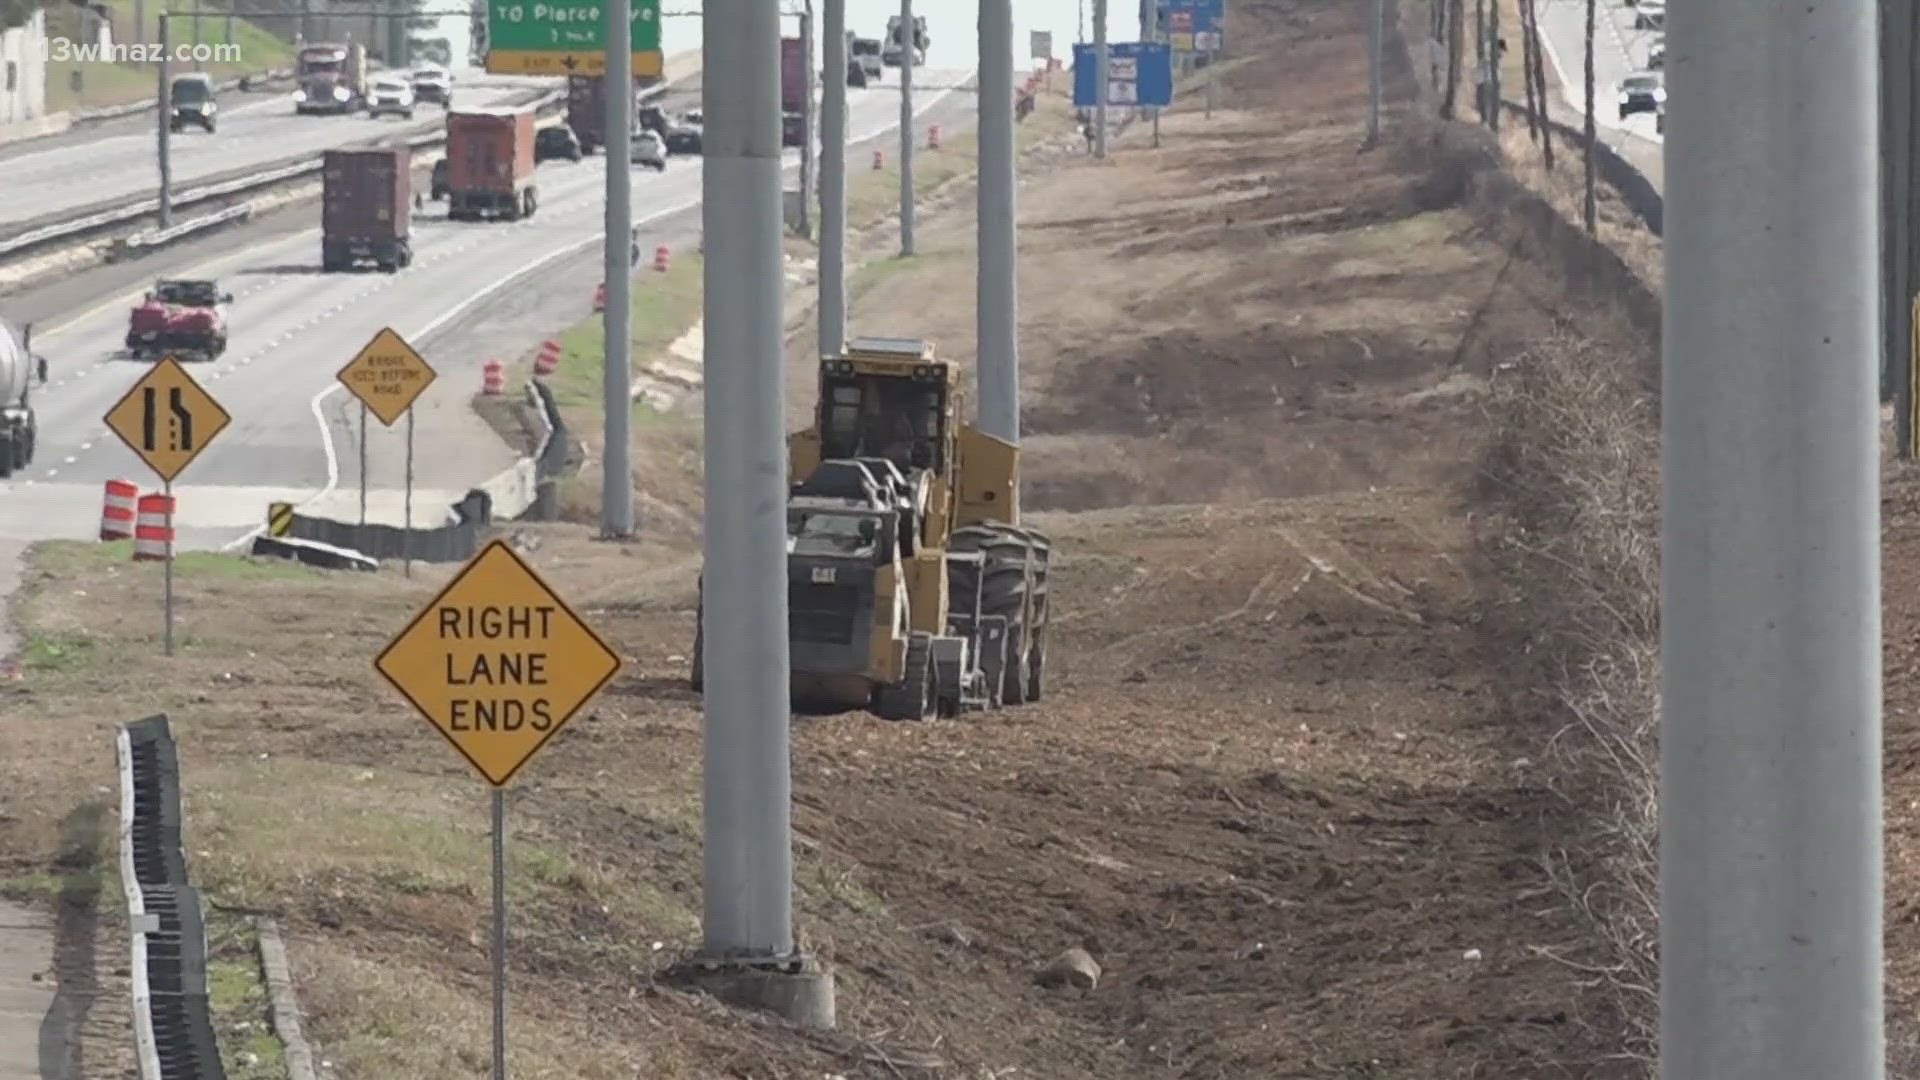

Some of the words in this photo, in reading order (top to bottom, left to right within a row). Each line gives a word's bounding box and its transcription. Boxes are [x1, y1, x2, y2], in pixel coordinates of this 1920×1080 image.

[534, 4, 601, 22] Pierce
[630, 7, 654, 22] ve
[438, 605, 556, 640] RIGHT
[446, 652, 548, 686] LANE
[450, 698, 553, 732] ENDS
